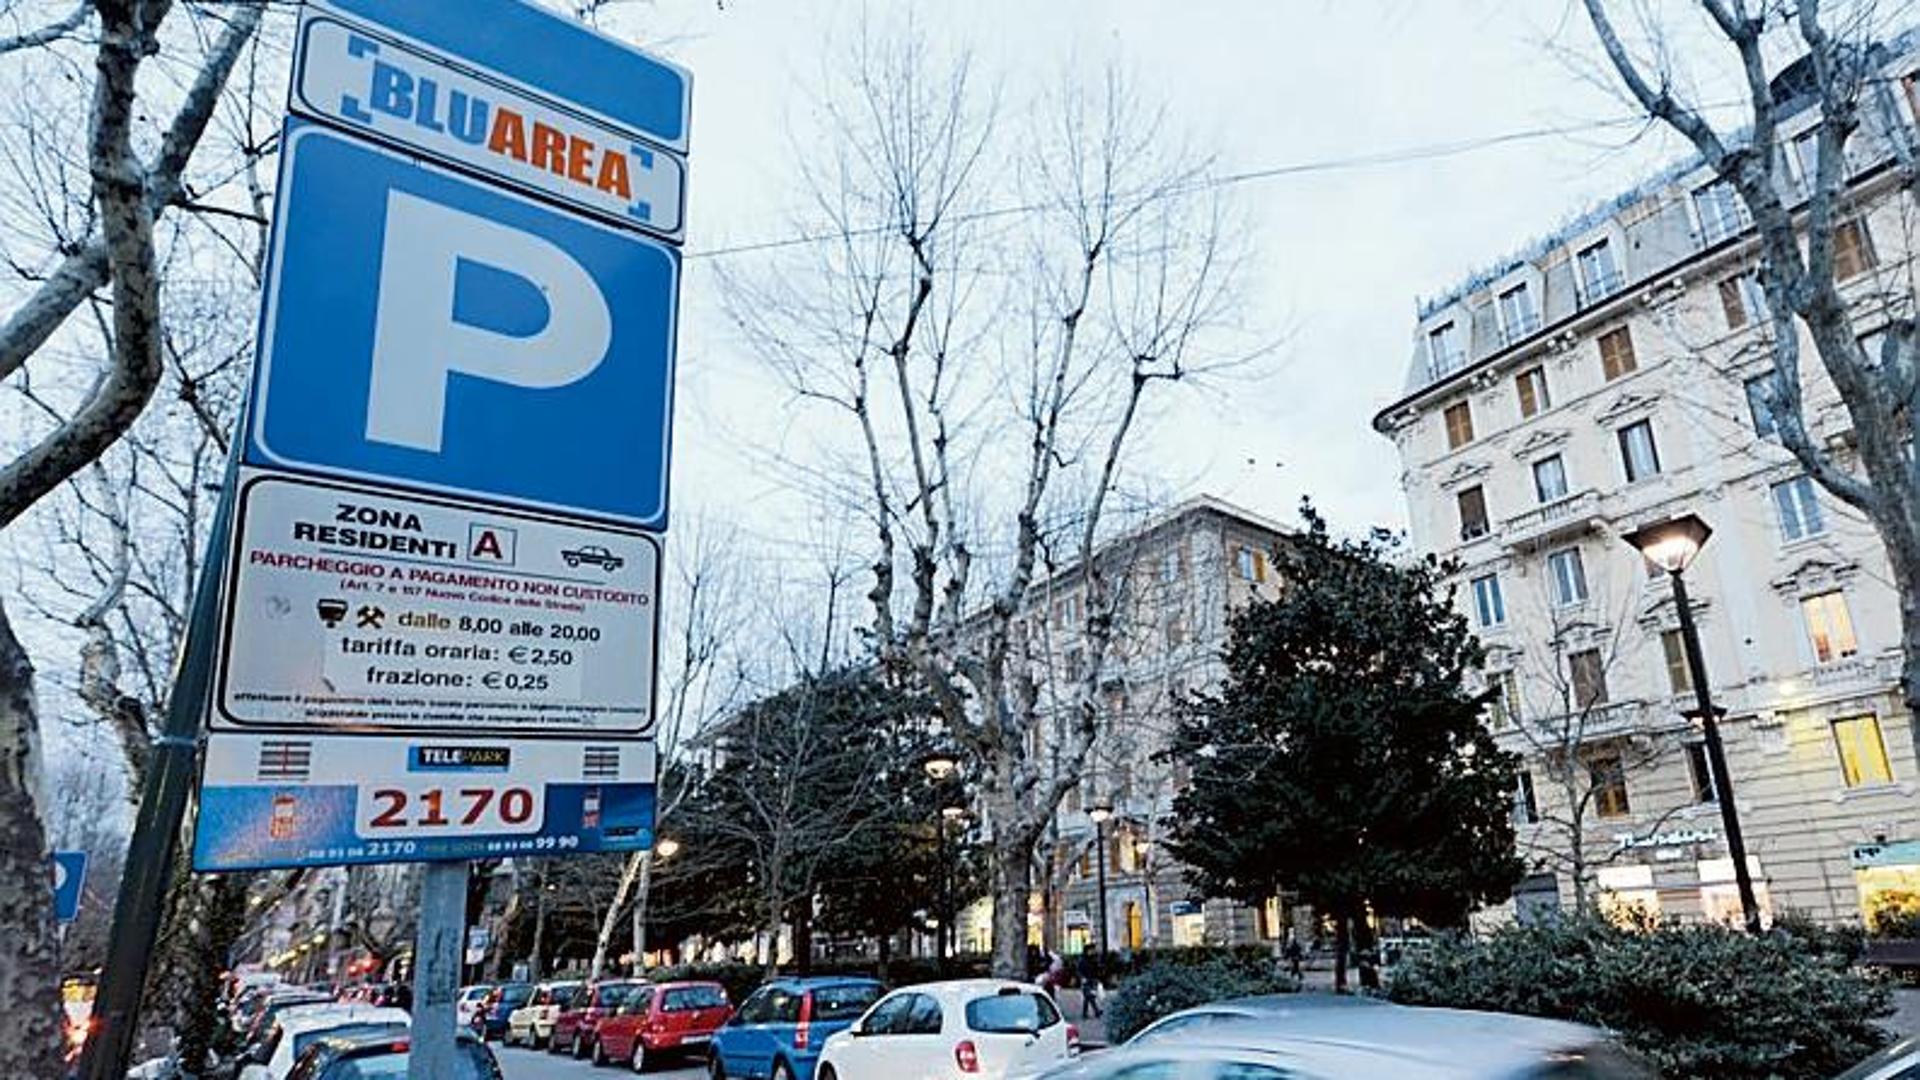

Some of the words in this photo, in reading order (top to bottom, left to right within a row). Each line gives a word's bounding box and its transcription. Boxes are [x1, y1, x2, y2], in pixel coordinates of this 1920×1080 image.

[369, 60, 633, 201] BLUAREA
[365, 187, 613, 454] P
[335, 503, 422, 532] ZONA
[293, 521, 458, 559] RESIDENTI
[472, 530, 503, 559] A
[250, 550, 386, 578] PARCHEGGIO
[389, 567, 404, 580] A
[408, 568, 520, 593] PAGAMENTO
[523, 581, 560, 596] NON
[562, 585, 650, 606] CUSTODITO
[375, 582, 385, 593] 7
[398, 611, 451, 630] dalle
[458, 615, 503, 636] 8,00
[508, 621, 545, 638] alle
[549, 624, 602, 643] 20,00
[341, 636, 416, 656] tariffa
[424, 642, 500, 661] oraria:
[366, 665, 474, 688] frazione:
[369, 787, 534, 828] 2170
[367, 840, 417, 857] 2170
